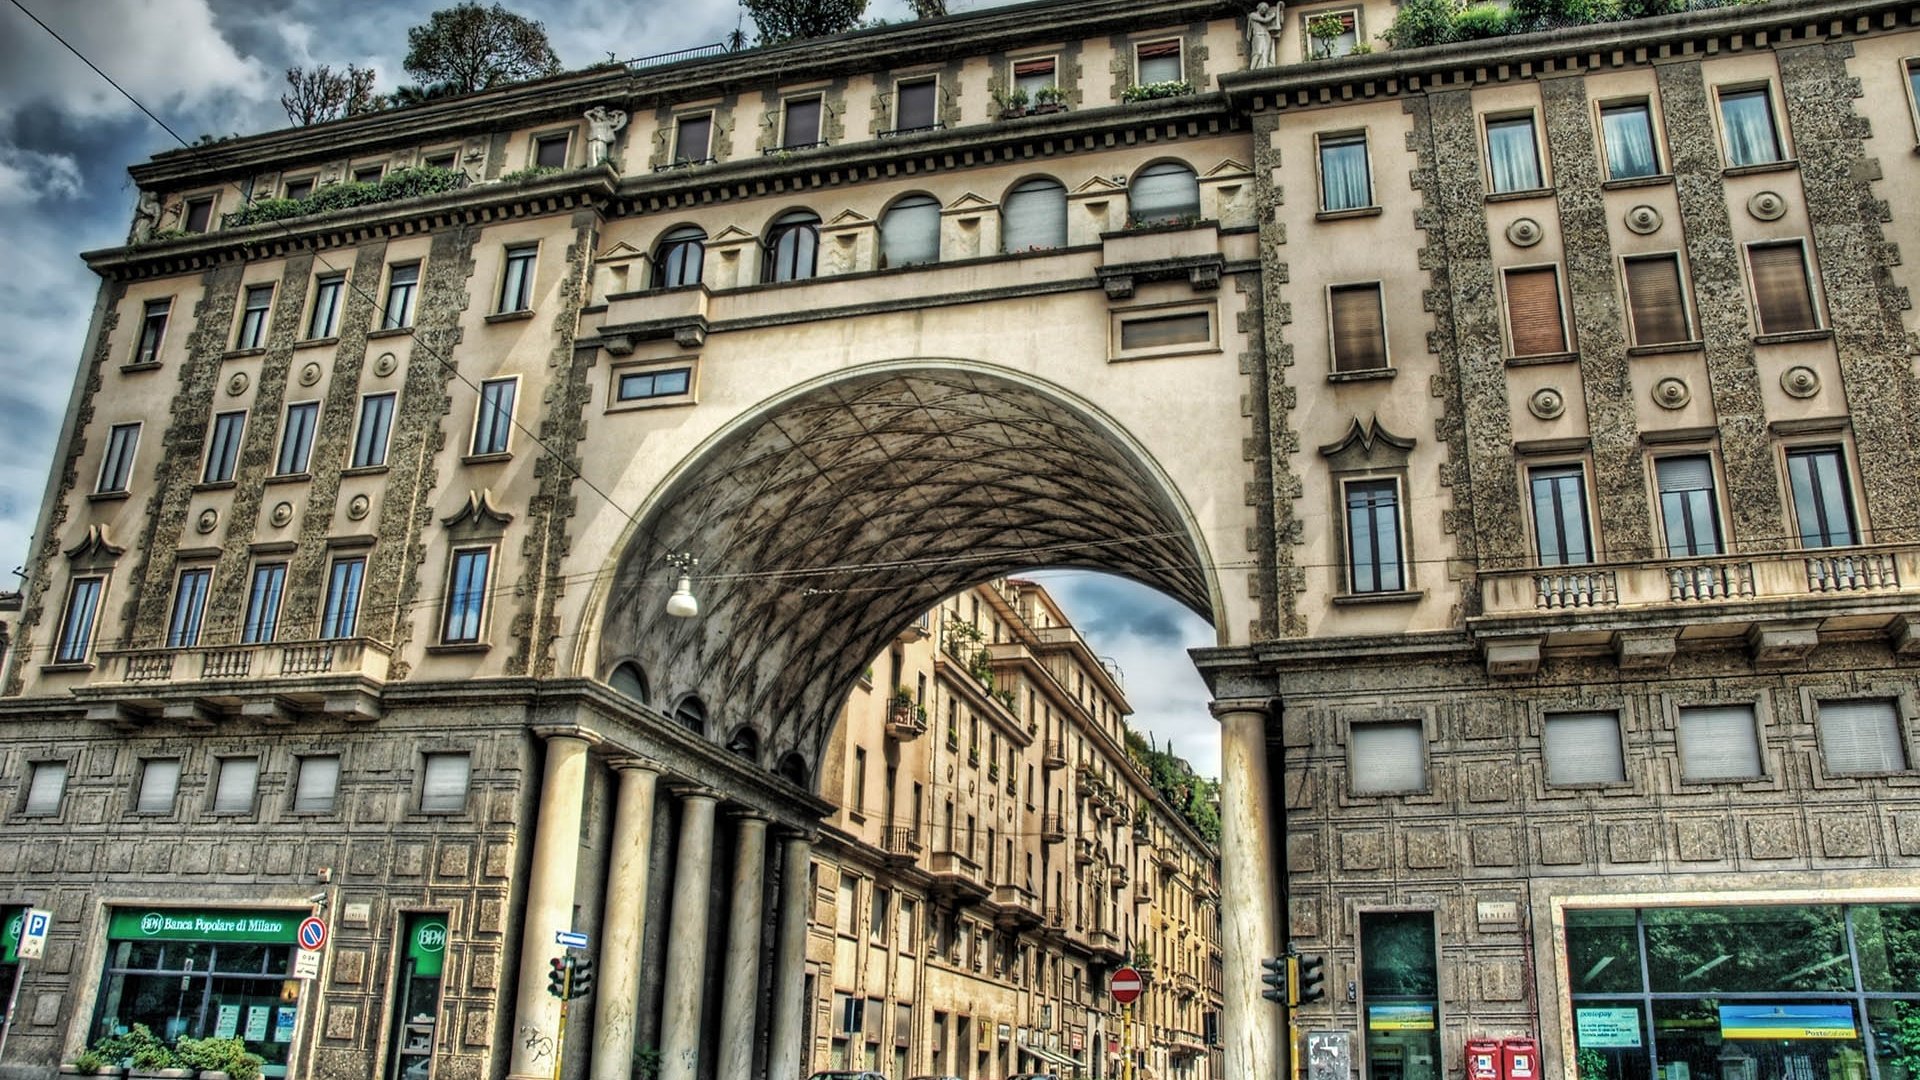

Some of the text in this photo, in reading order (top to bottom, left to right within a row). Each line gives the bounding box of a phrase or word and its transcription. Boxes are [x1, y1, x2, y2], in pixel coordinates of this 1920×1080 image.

[31, 917, 44, 934] P
[164, 918, 193, 930] Banca
[194, 918, 235, 933] Popolare
[236, 919, 247, 931] di
[247, 919, 282, 932] Milano
[419, 929, 446, 945] BPM
